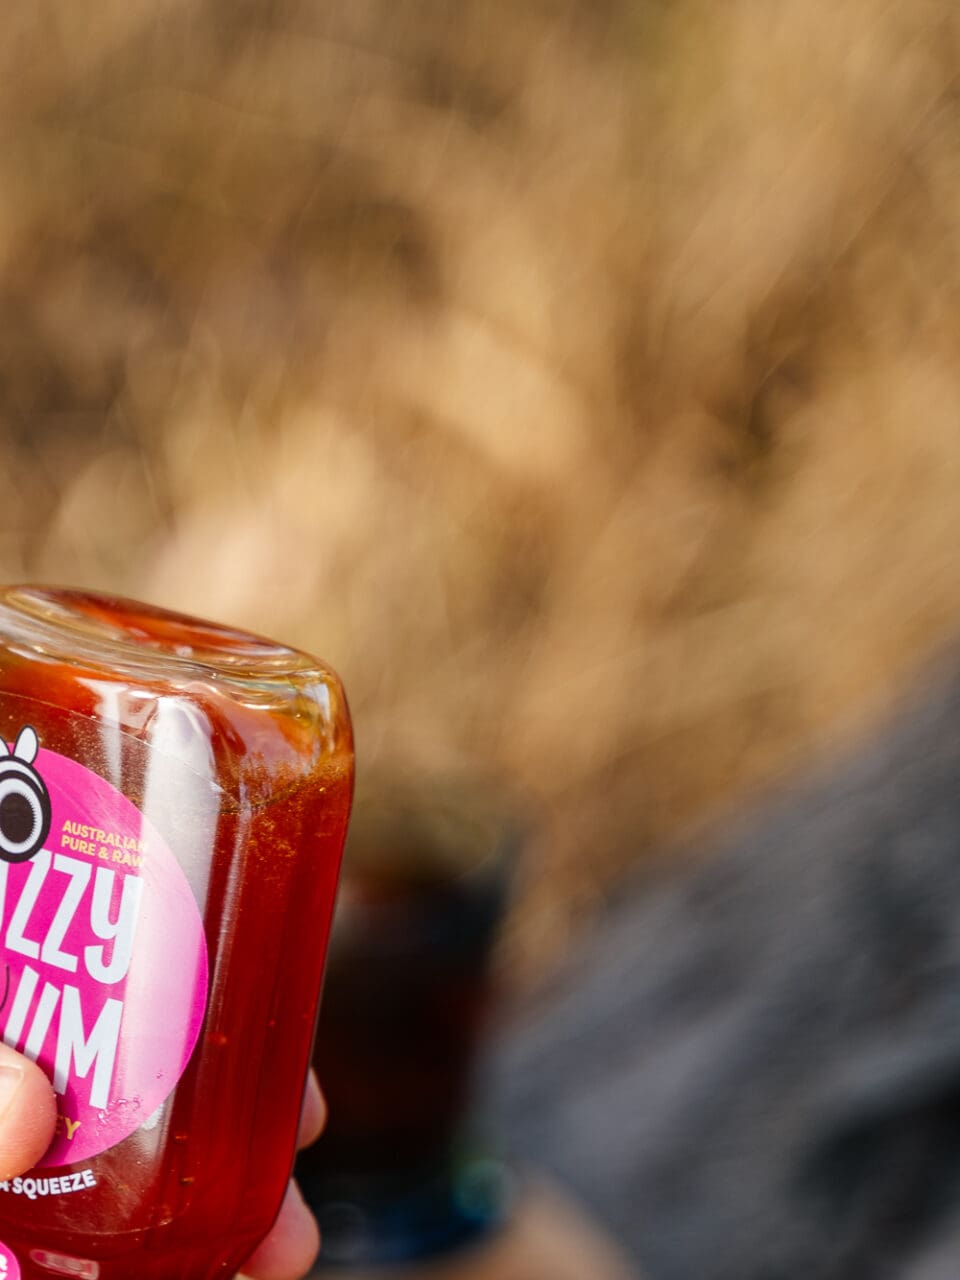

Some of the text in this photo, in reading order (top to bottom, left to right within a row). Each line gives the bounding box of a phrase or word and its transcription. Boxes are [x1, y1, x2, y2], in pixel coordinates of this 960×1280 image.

[61, 835, 97, 856] PURE
[98, 847, 109, 860] &
[12, 1169, 97, 1200] SQUEEZE
